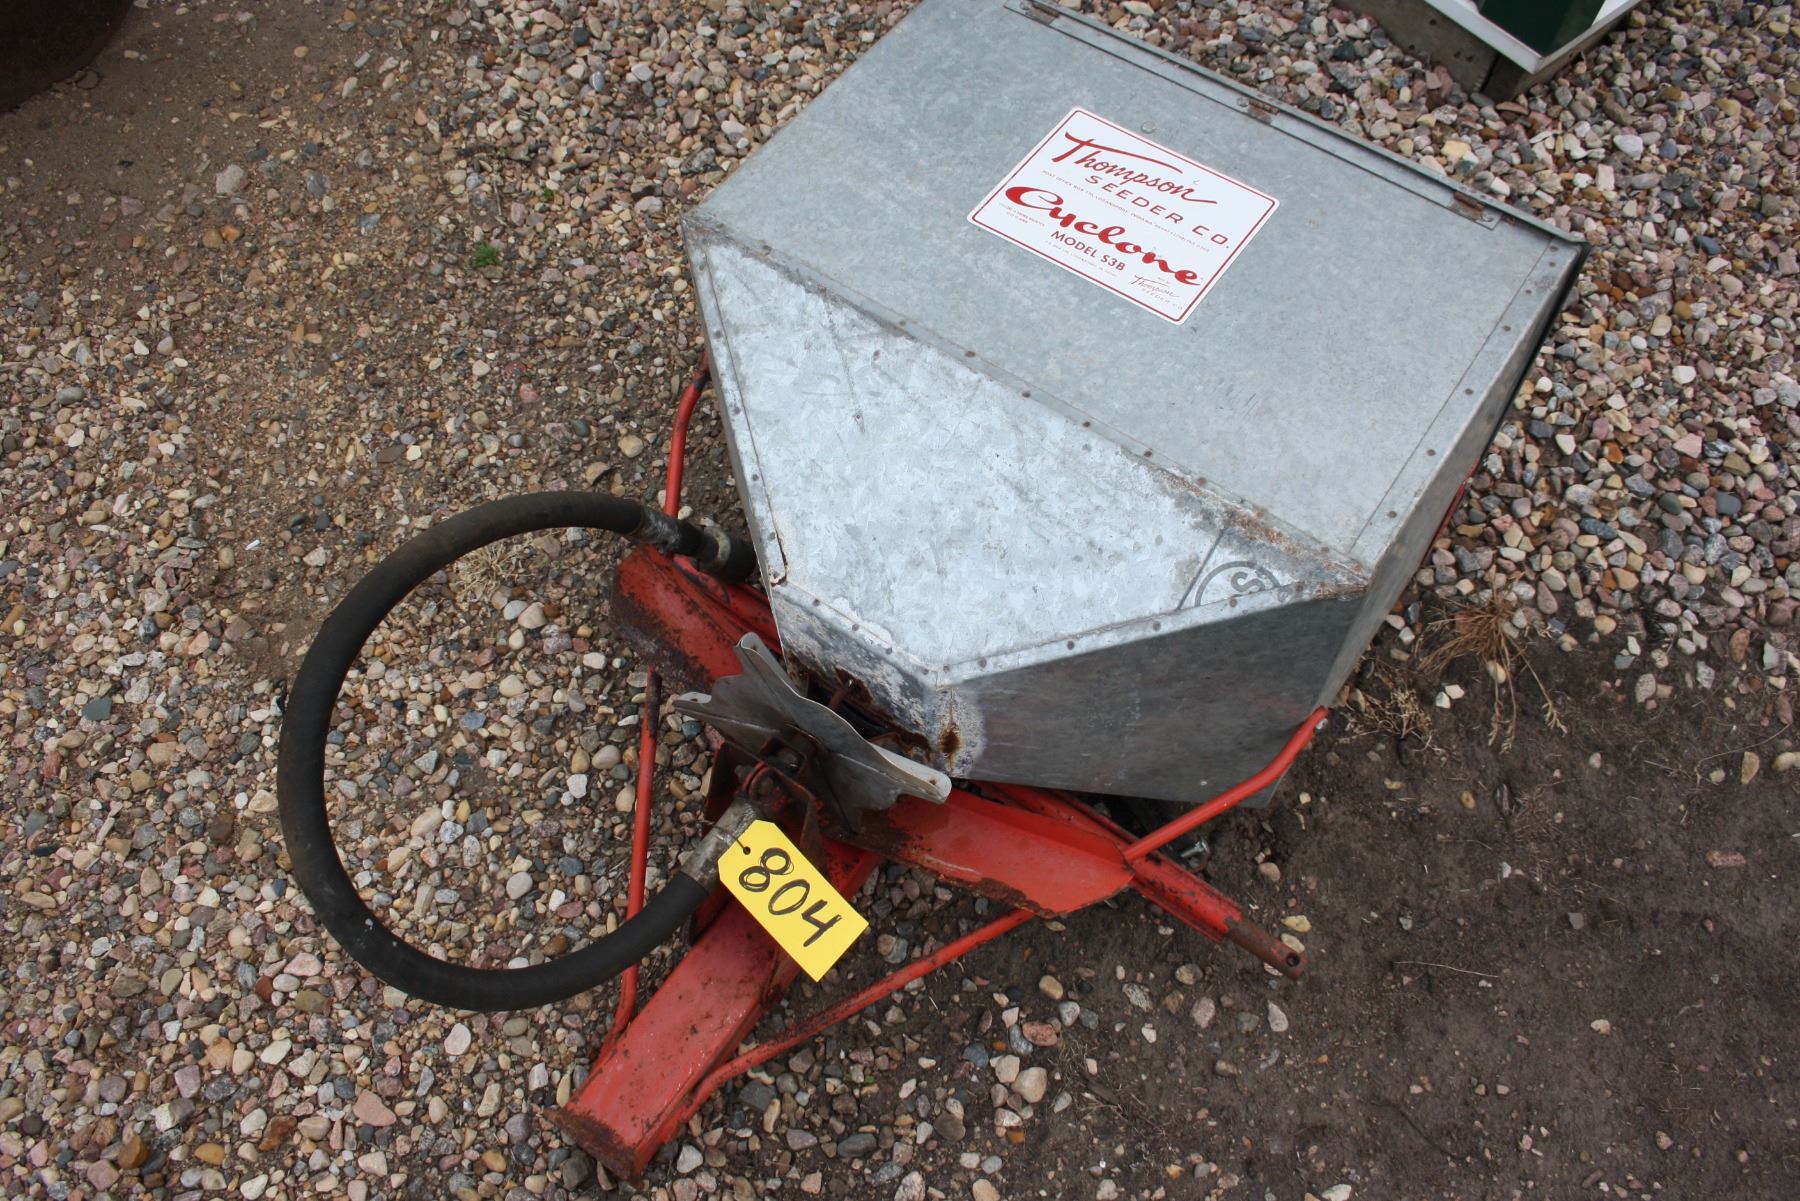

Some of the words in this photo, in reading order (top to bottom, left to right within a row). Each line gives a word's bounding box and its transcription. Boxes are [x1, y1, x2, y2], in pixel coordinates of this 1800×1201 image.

[1051, 131, 1218, 204] Thompson
[1085, 175, 1184, 224] SEEDER
[1005, 186, 1201, 286] Cyclone
[1050, 230, 1097, 259] MODEL
[1100, 251, 1126, 272] S3B
[739, 847, 843, 948] 804
